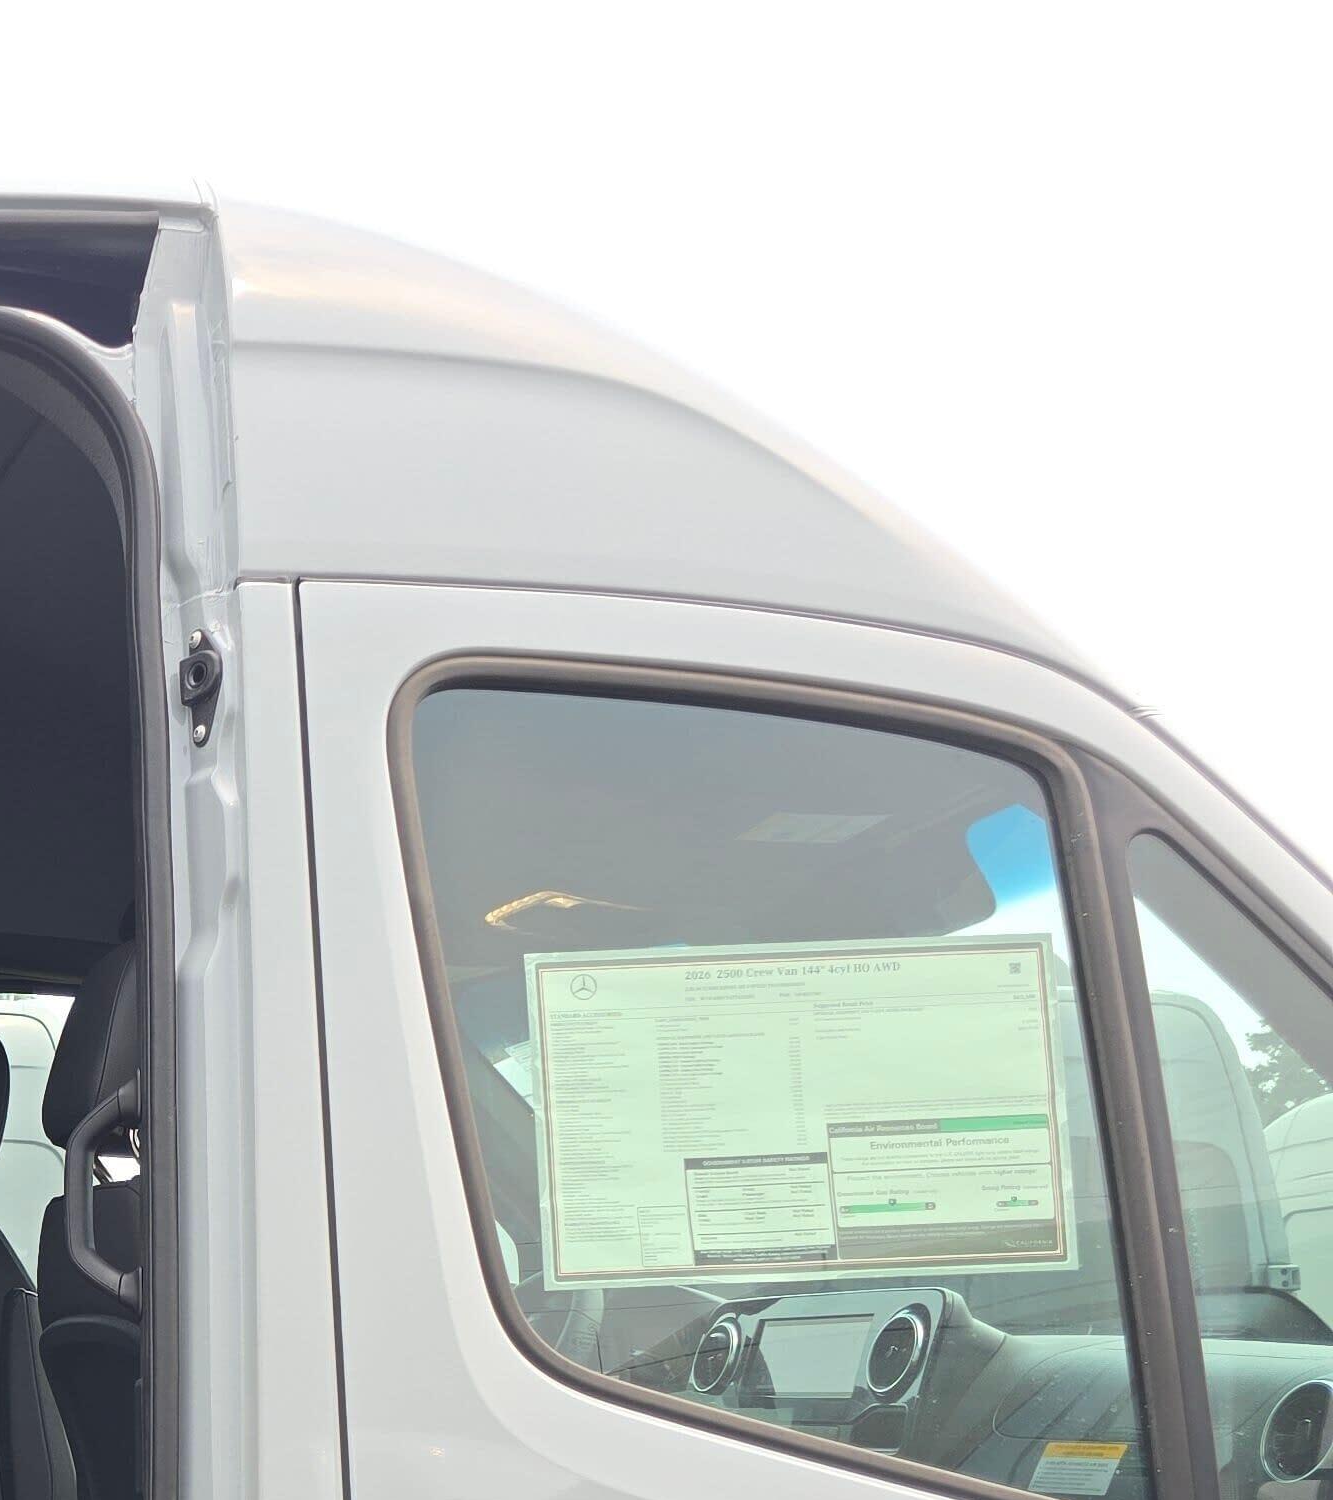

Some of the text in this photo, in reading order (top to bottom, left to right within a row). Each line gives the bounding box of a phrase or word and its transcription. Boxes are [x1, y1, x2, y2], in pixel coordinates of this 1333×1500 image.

[684, 970, 711, 980] 2026
[716, 969, 743, 979] 2500
[745, 967, 773, 978] Crew
[777, 967, 798, 976] Van
[853, 963, 870, 973] HO
[873, 961, 901, 972] AWD
[870, 1136, 1010, 1150] Environmental Performance
